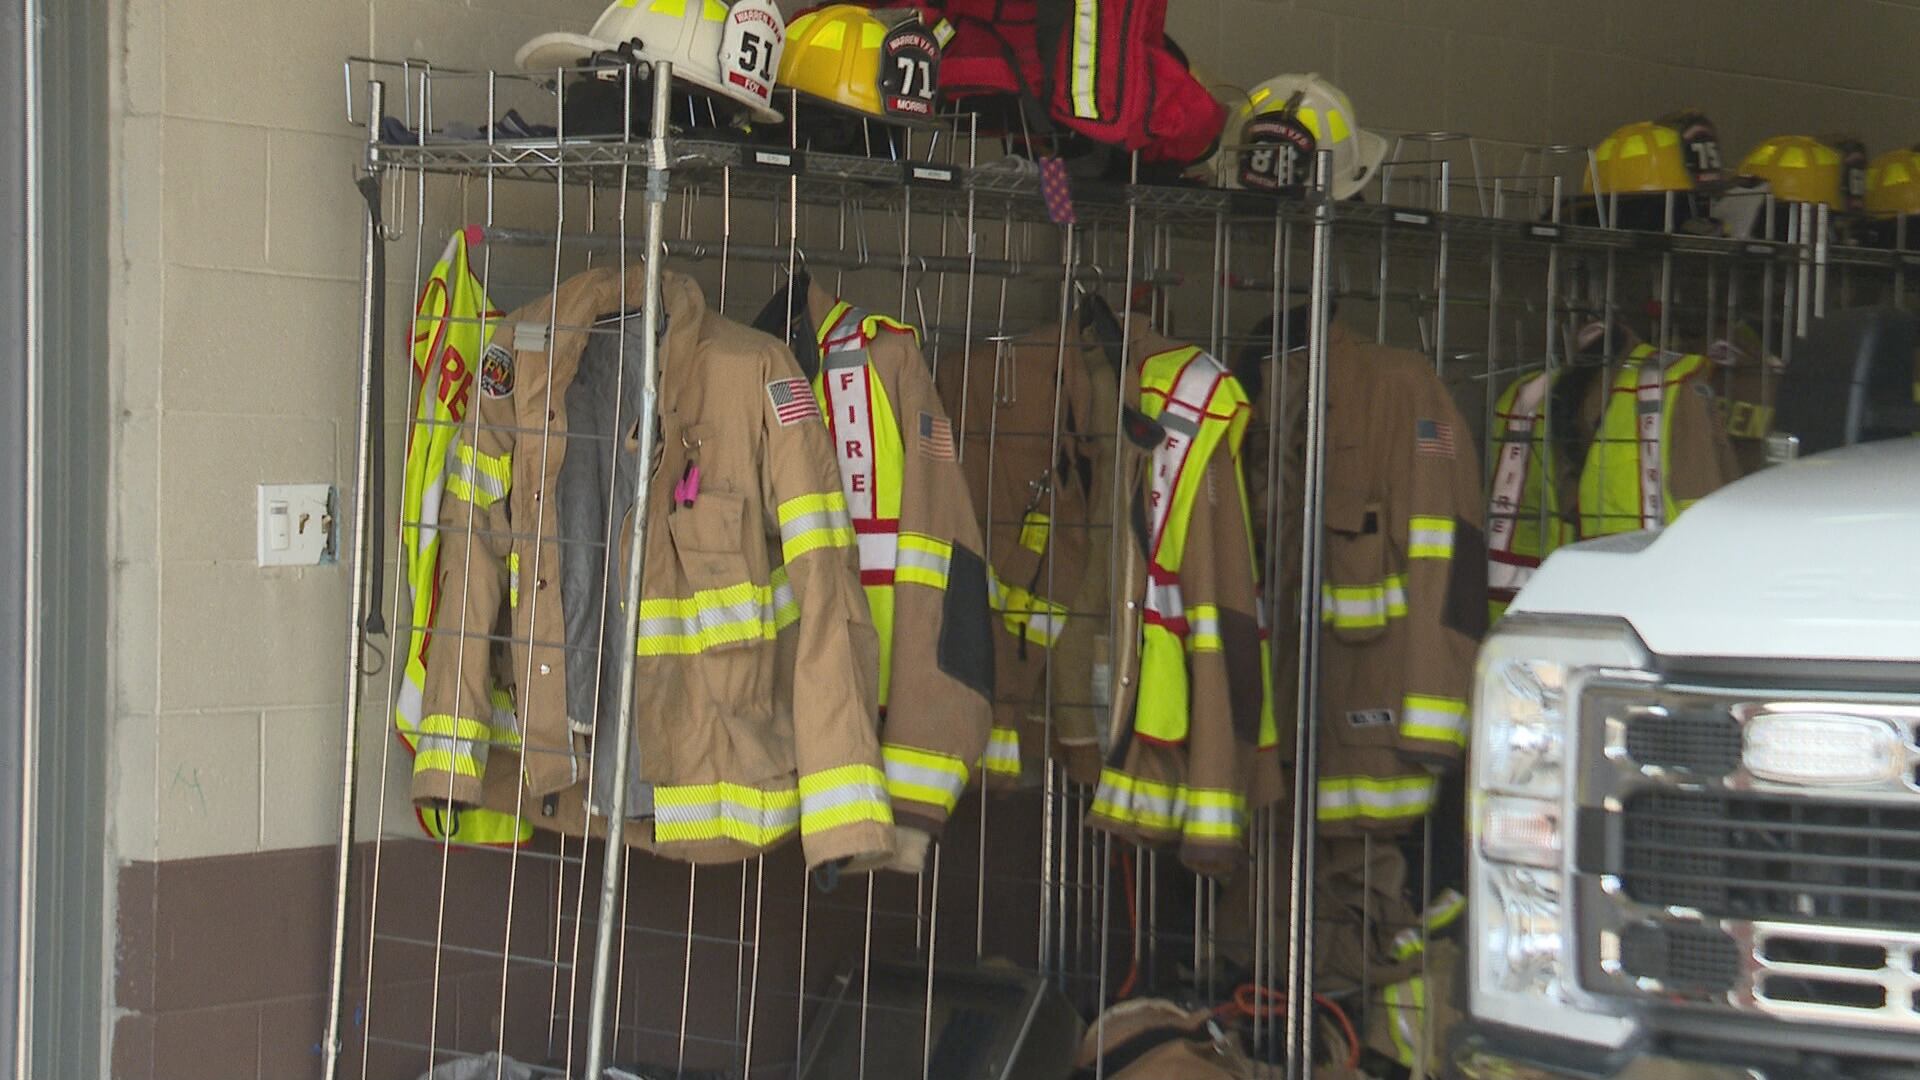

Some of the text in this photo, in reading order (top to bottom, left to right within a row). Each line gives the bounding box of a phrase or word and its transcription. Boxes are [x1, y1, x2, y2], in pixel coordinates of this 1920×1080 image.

[736, 9, 769, 24] WARREN
[739, 31, 772, 81] 51
[889, 35, 920, 51] WARREN
[897, 57, 933, 99] 71
[840, 372, 866, 493] FIRE
[1492, 446, 1521, 533] FIRE
